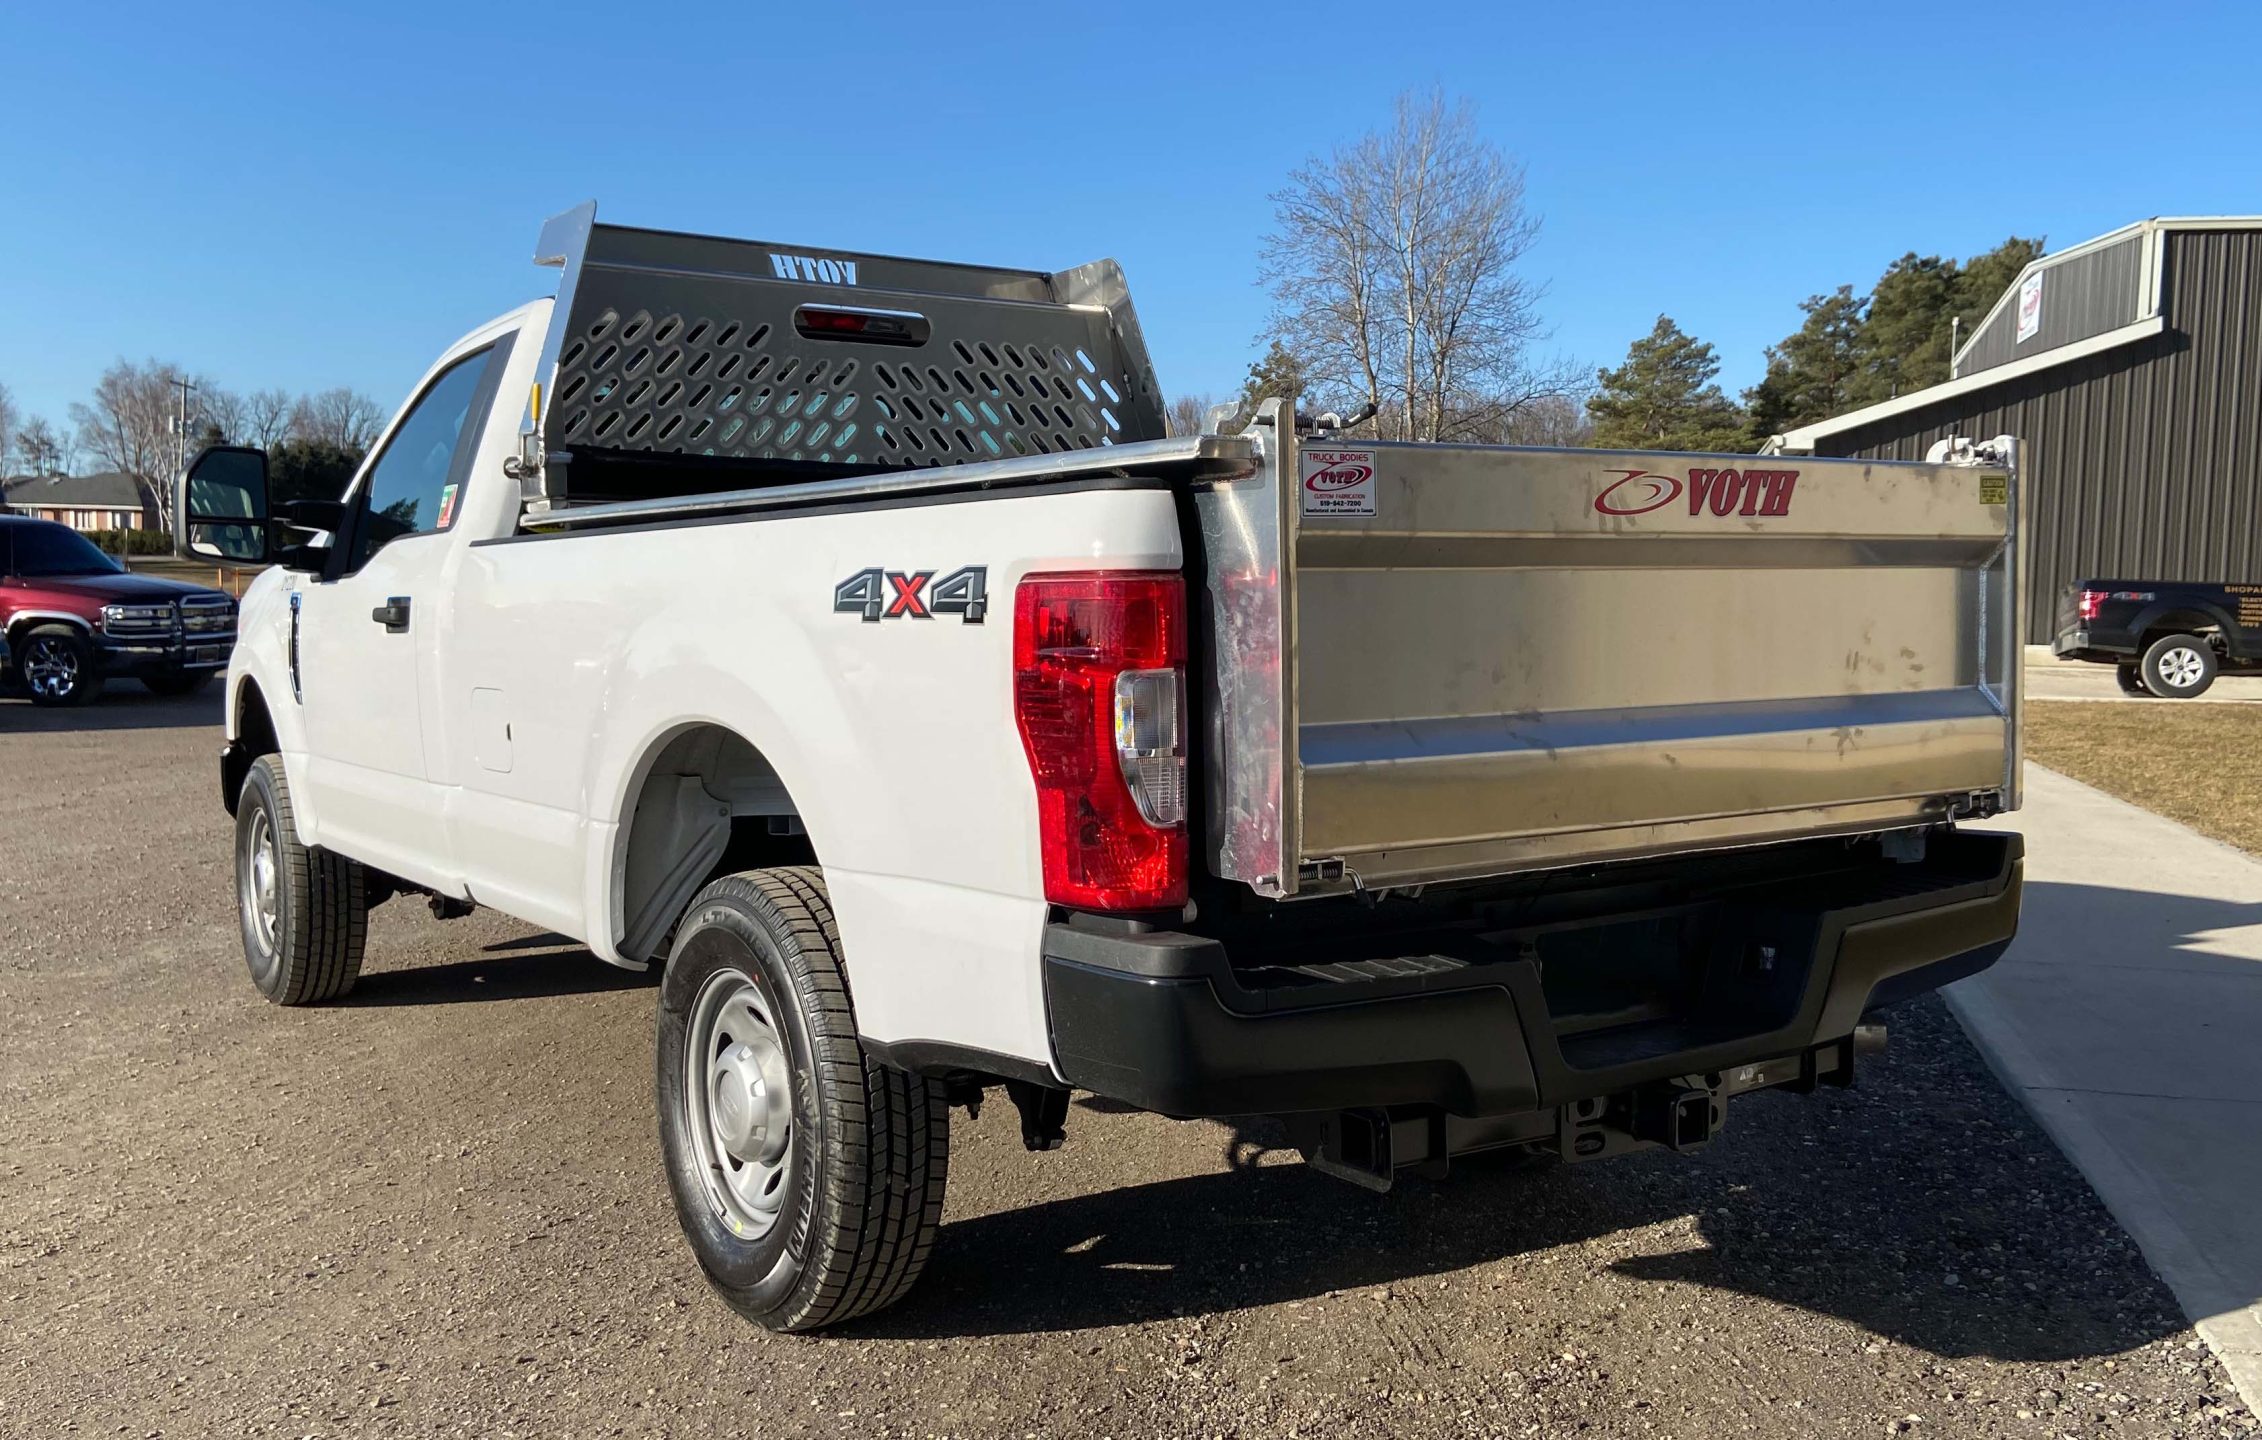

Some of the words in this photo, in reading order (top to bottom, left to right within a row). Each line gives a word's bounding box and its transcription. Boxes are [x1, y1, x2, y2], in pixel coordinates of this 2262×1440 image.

[1308, 453, 1334, 461] TRUCK
[1340, 453, 1368, 461] BODIES
[1688, 468, 1799, 516] VOTH
